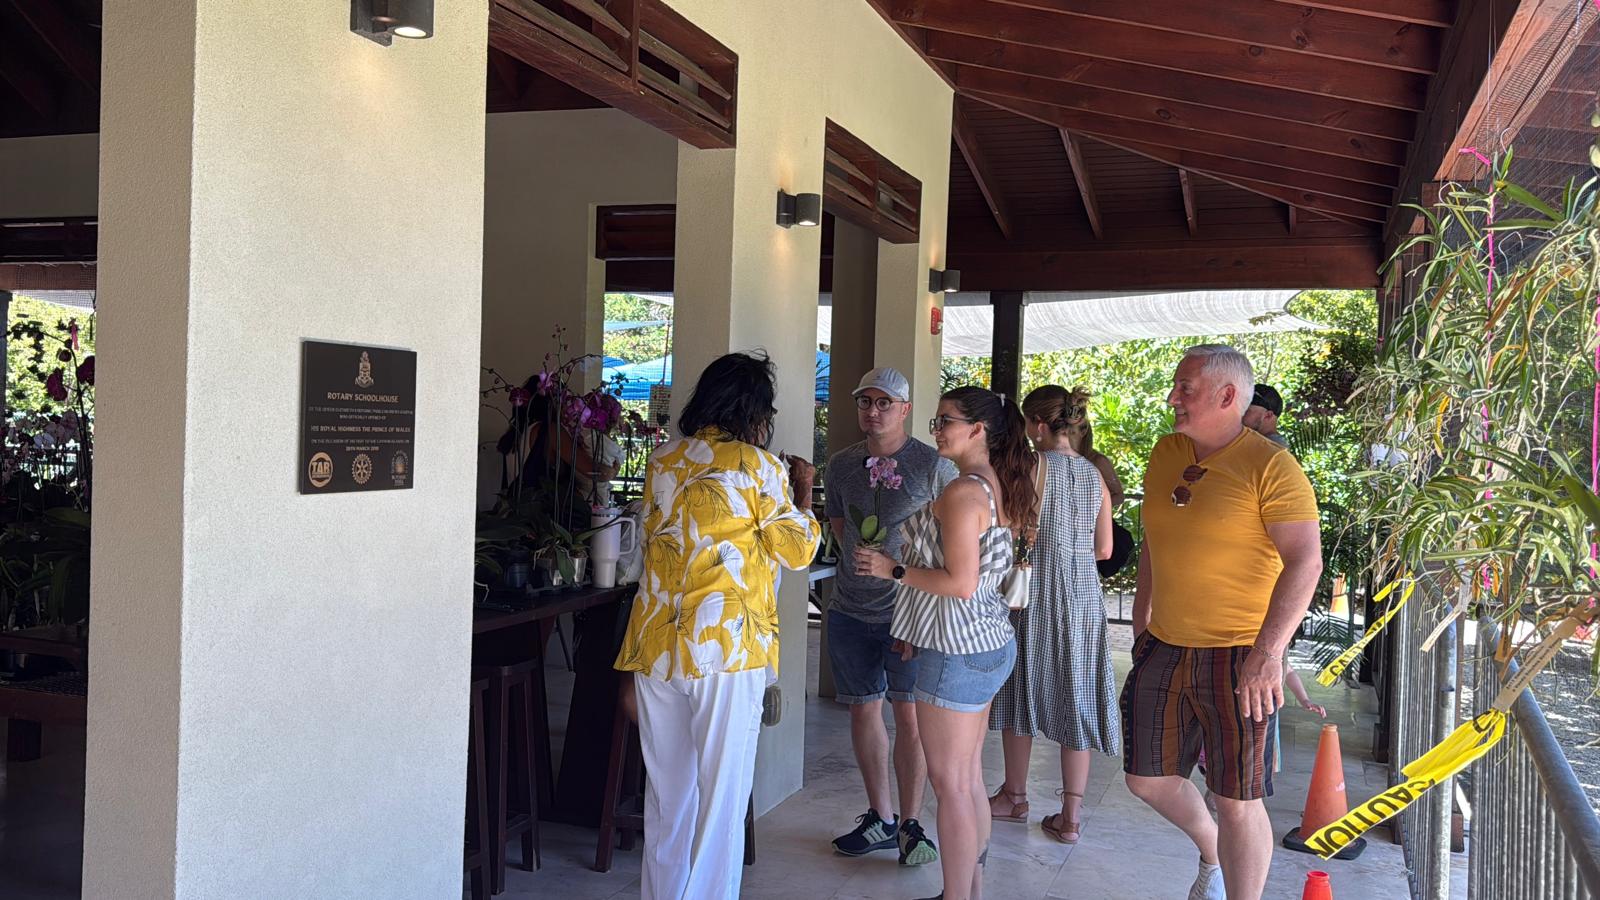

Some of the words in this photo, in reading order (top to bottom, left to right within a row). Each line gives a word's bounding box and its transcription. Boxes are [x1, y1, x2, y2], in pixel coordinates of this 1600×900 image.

[327, 392, 353, 400] ROTARY
[354, 393, 399, 403] SCHOOLHOUSE
[311, 461, 330, 475] TAR
